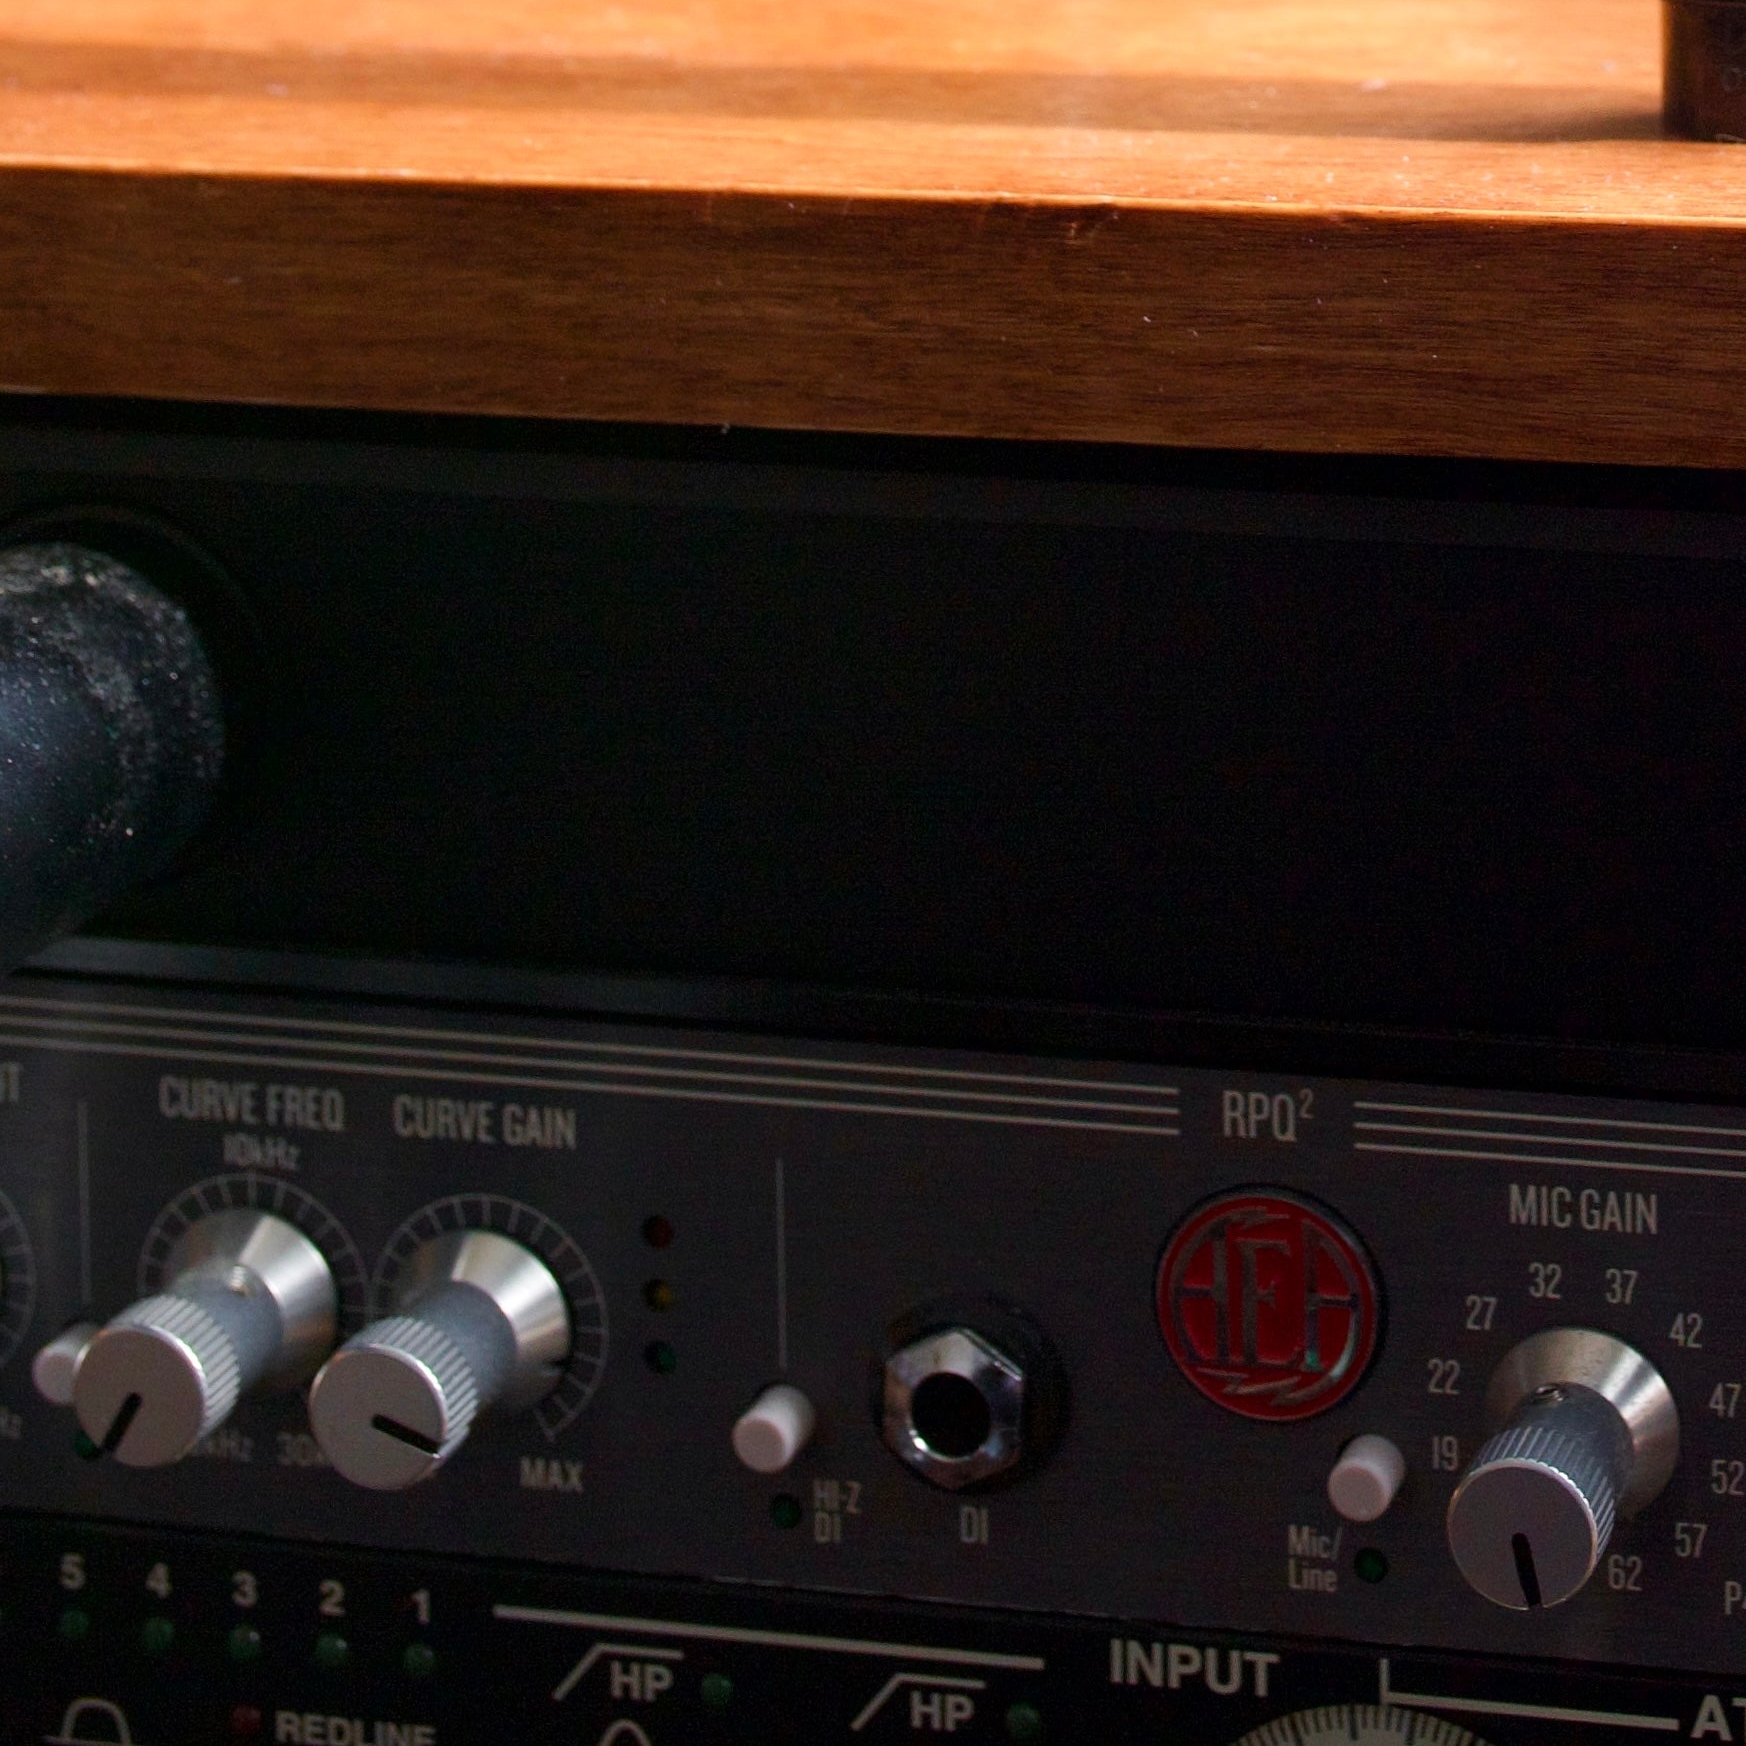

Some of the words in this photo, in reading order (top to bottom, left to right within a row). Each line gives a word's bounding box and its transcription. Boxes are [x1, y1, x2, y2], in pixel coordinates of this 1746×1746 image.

[158, 1075, 256, 1126] CURVE
[265, 1088, 346, 1133] FREQ
[392, 1095, 496, 1147] CURVE
[503, 1104, 578, 1150] GAIN
[1508, 1183, 1572, 1229] MIC
[1580, 1192, 1659, 1236] GAIN
[1529, 1262, 1562, 1300] 32
[1604, 1268, 1639, 1305] 37
[1465, 1295, 1498, 1331] 27
[1668, 1313, 1703, 1349] 42
[1427, 1358, 1461, 1395] 22
[1708, 1382, 1741, 1418] 47
[1432, 1435, 1459, 1471] 19
[519, 1456, 584, 1492] MAX
[1710, 1460, 1746, 1496] 52
[813, 1511, 841, 1544] DI
[959, 1506, 989, 1545] DI
[1287, 1522, 1342, 1561] Mic/
[1674, 1522, 1708, 1559] 57
[60, 1553, 86, 1589] 5
[145, 1562, 173, 1598] 4
[232, 1571, 258, 1606] 3
[318, 1579, 346, 1616] 2
[411, 1588, 432, 1624] 1
[1287, 1556, 1339, 1593] Line
[1607, 1554, 1643, 1593] 62
[610, 1661, 675, 1703] HP
[1108, 1638, 1281, 1699] INPUT
[275, 1712, 437, 1746] REDLINE
[909, 1691, 976, 1732] HP
